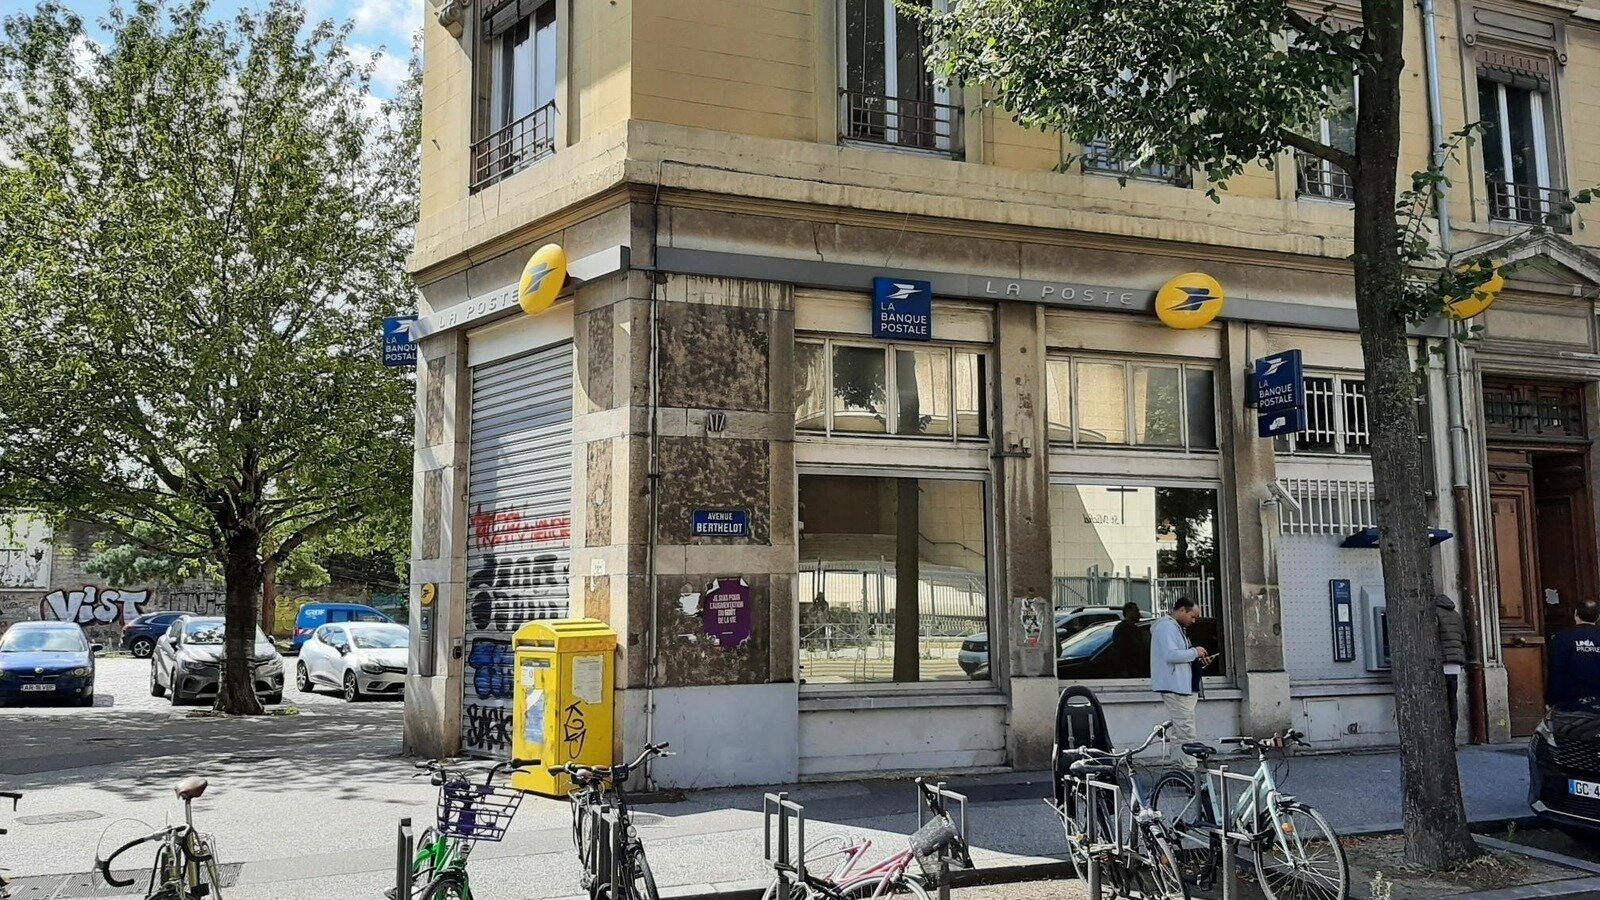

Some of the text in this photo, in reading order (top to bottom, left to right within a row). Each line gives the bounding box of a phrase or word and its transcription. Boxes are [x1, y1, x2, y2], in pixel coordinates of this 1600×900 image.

[985, 280, 1134, 305] LA POSTE
[880, 301, 896, 311] LA
[439, 313, 458, 329] LA
[880, 312, 928, 325] BANQUE
[880, 323, 929, 335] POSTALE
[386, 336, 397, 344] LA
[385, 344, 417, 353] BANQU
[385, 353, 417, 361] POSTAL
[1259, 379, 1269, 388] LA
[1259, 383, 1293, 399] BANQUE
[1260, 394, 1293, 407] POSTALE
[707, 512, 734, 521] AVENUE
[696, 522, 743, 533] BERTHELOT
